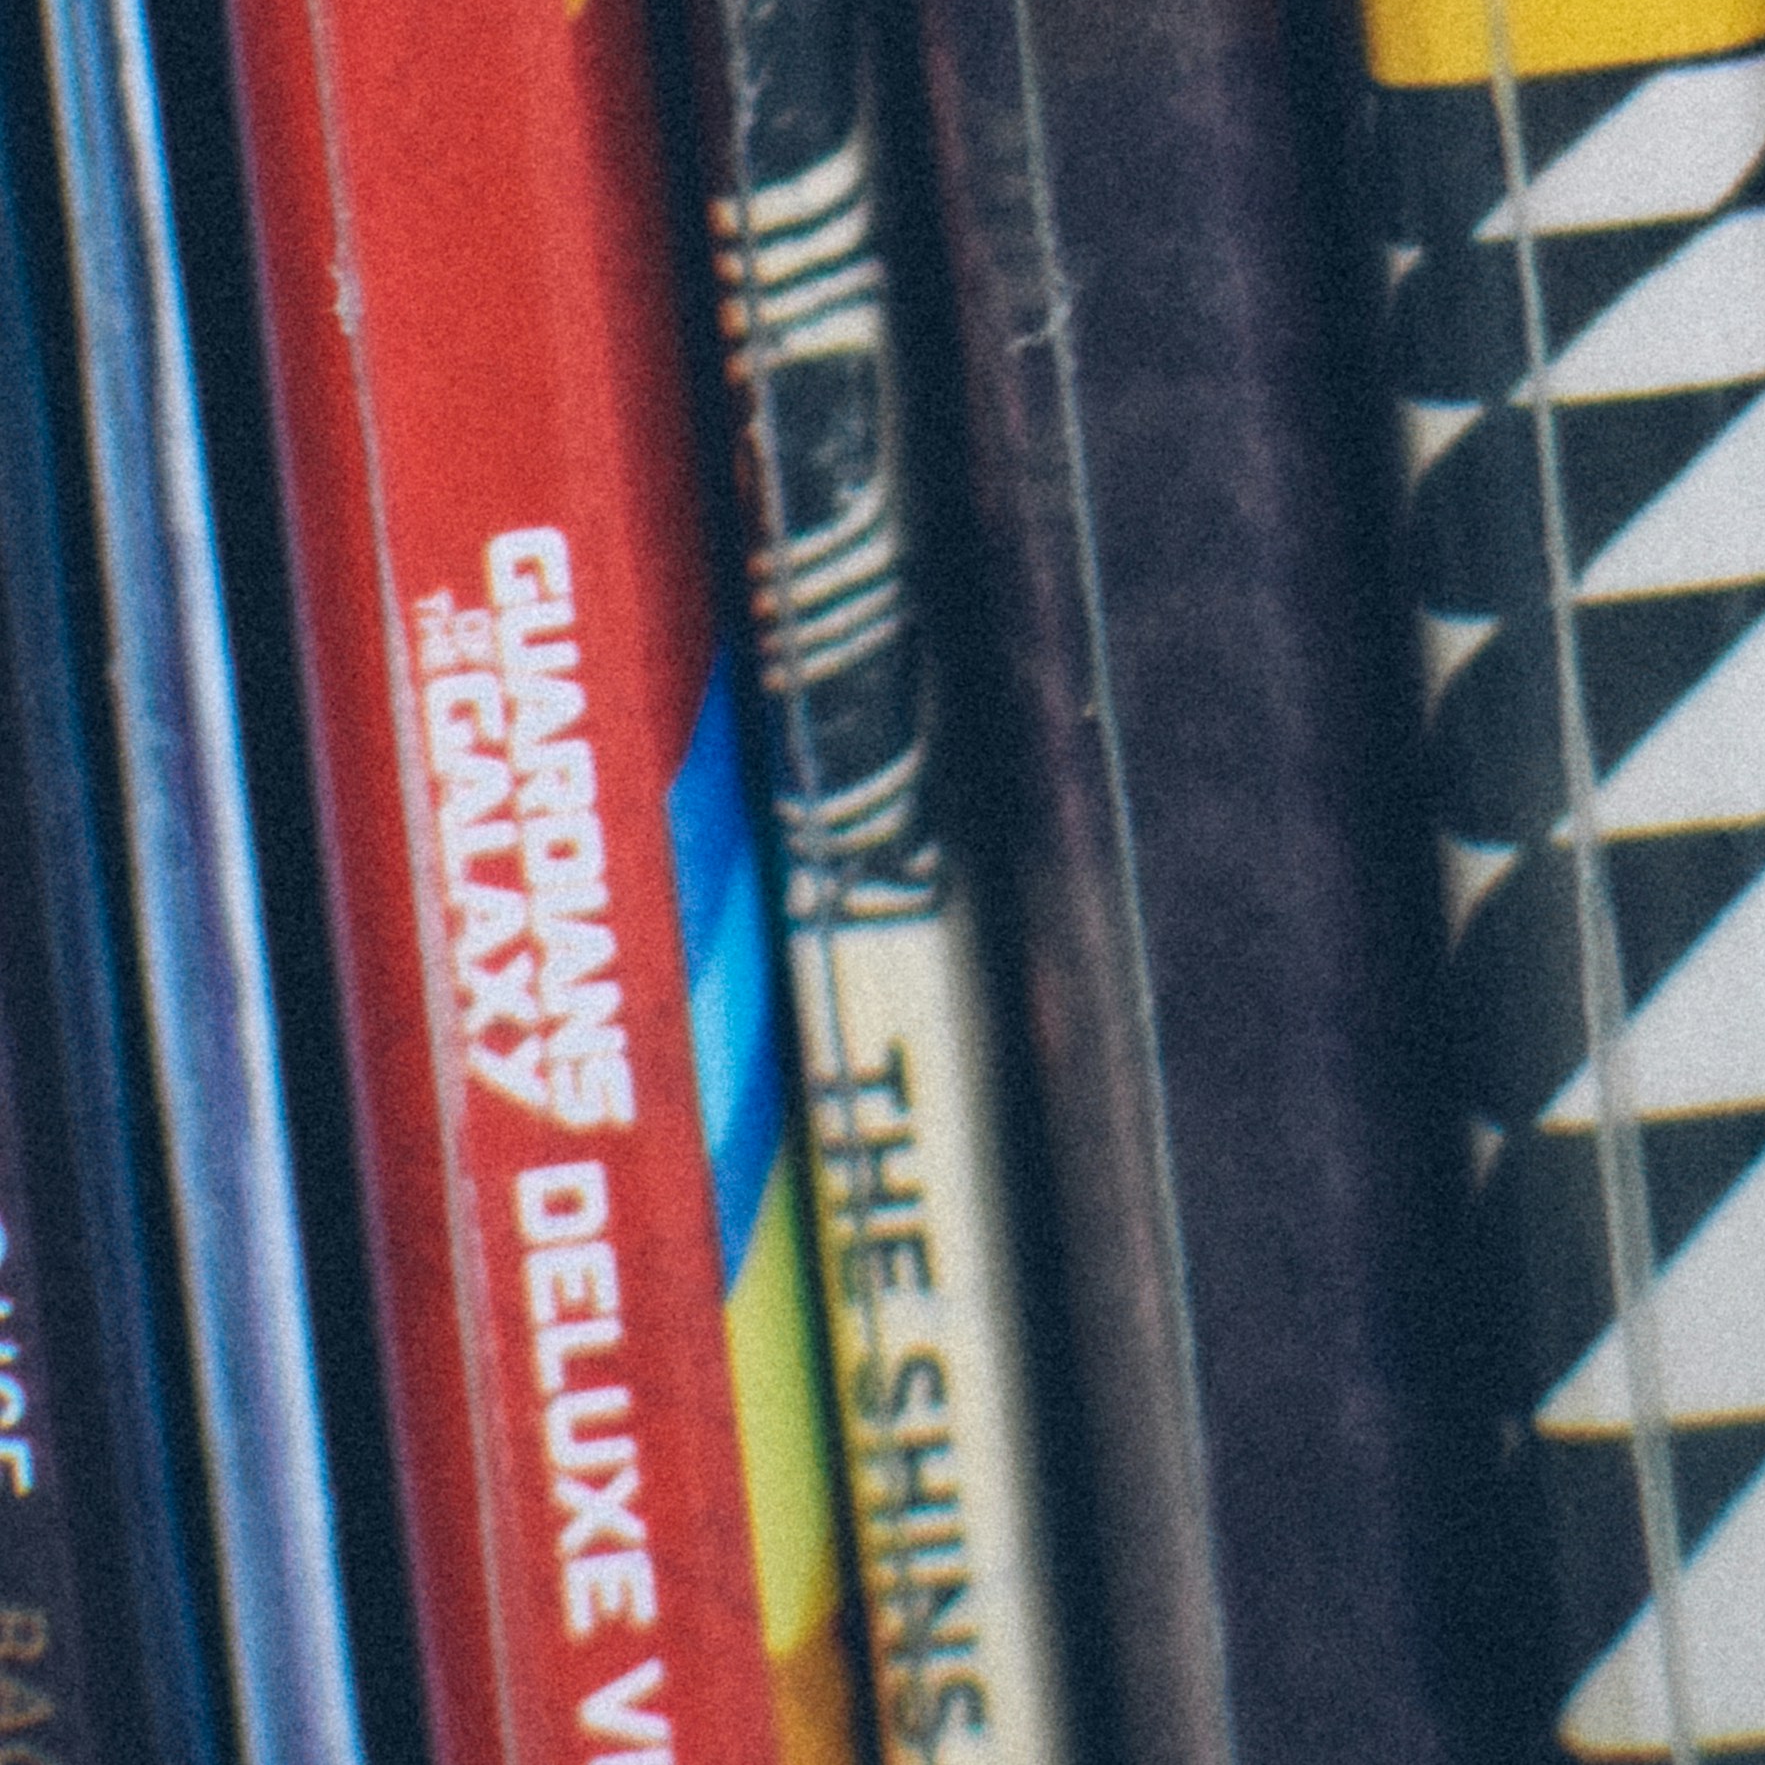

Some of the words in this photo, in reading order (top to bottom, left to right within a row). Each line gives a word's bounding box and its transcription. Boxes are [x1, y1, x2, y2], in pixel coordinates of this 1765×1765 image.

[423, 670, 553, 1110] GALAXY
[483, 525, 638, 1129] GUARDIANS
[808, 1035, 938, 1308] THE
[513, 1159, 660, 1641] DELUXE
[850, 1342, 992, 1754] SHINS
